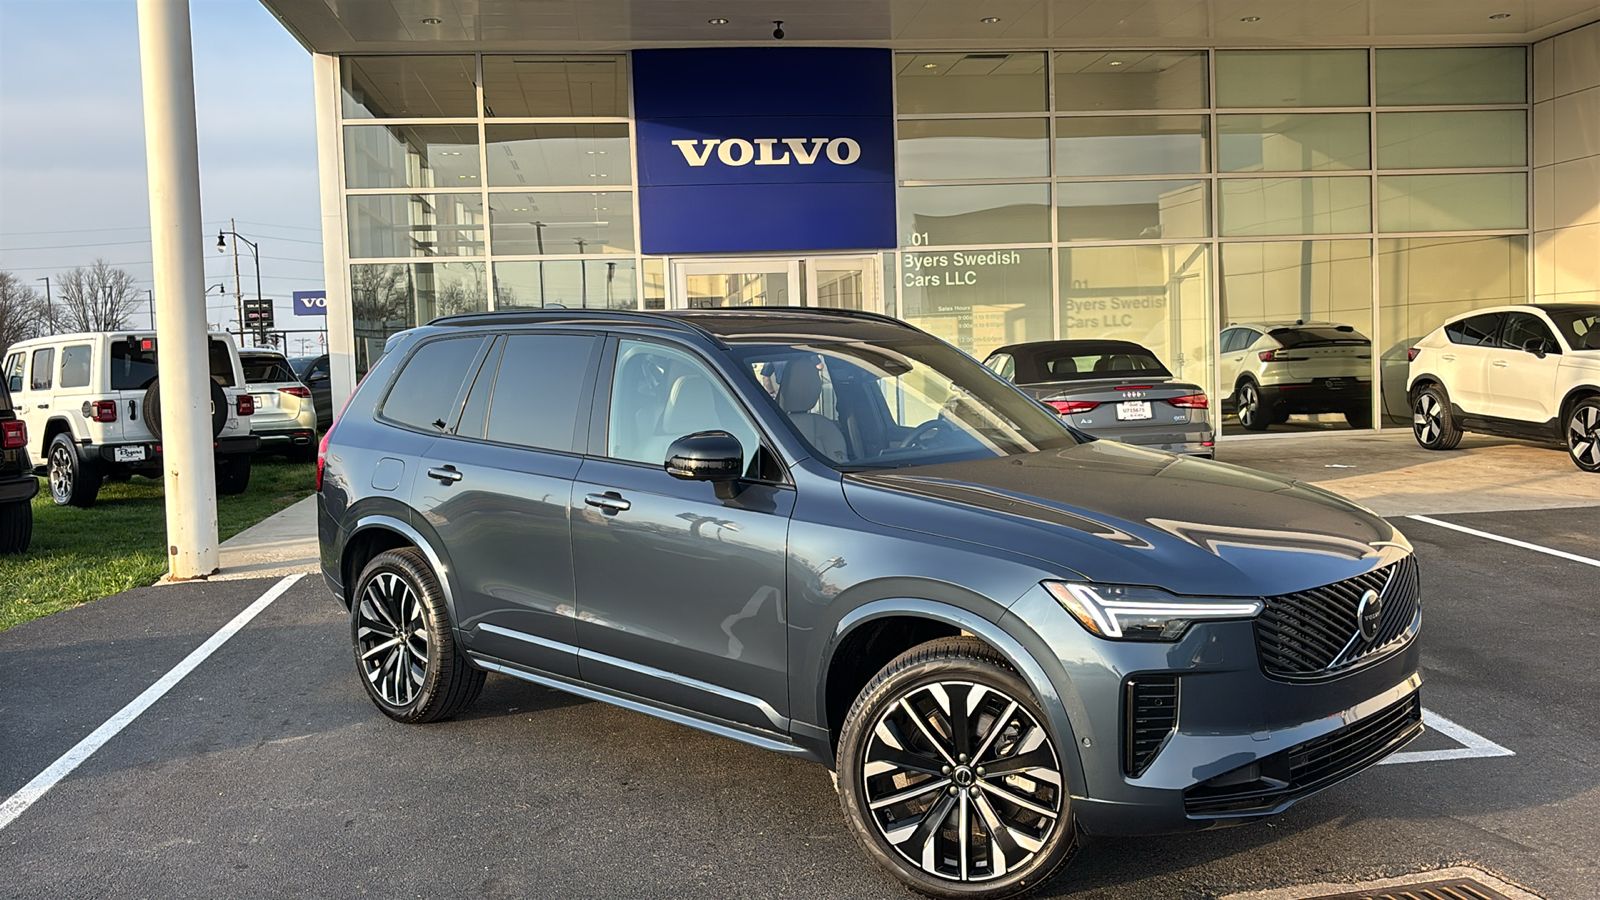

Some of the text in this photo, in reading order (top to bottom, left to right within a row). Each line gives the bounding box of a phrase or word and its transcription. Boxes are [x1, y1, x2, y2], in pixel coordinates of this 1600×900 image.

[671, 138, 861, 167] VOLVO
[904, 251, 1020, 271] Byers Swedish
[905, 271, 977, 287] Cars LLC
[1103, 314, 1132, 327] LLC
